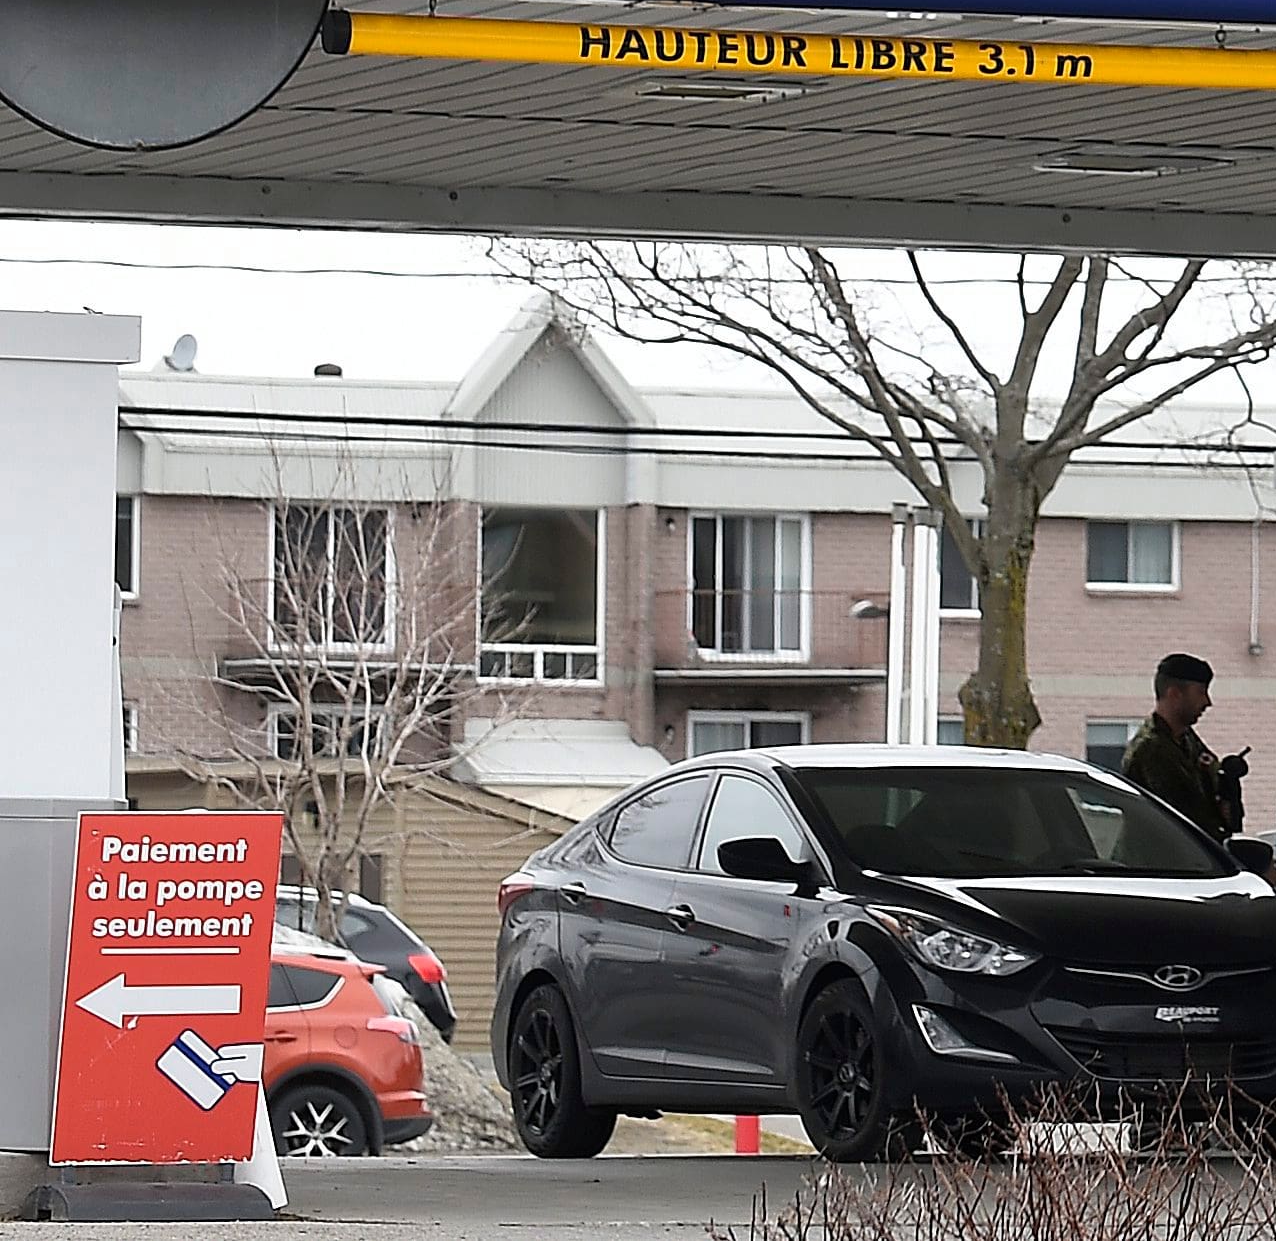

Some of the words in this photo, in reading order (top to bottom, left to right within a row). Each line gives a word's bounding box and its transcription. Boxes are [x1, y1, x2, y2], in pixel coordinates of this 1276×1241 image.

[580, 26, 808, 68] HAUTEUR
[829, 37, 955, 73] LIBRE
[977, 43, 1035, 77] 3.1
[1055, 50, 1093, 78] m
[101, 835, 248, 864] Paiement
[86, 873, 108, 901] à
[117, 872, 148, 901] la
[156, 877, 264, 906] pompe
[91, 911, 253, 939] seulement
